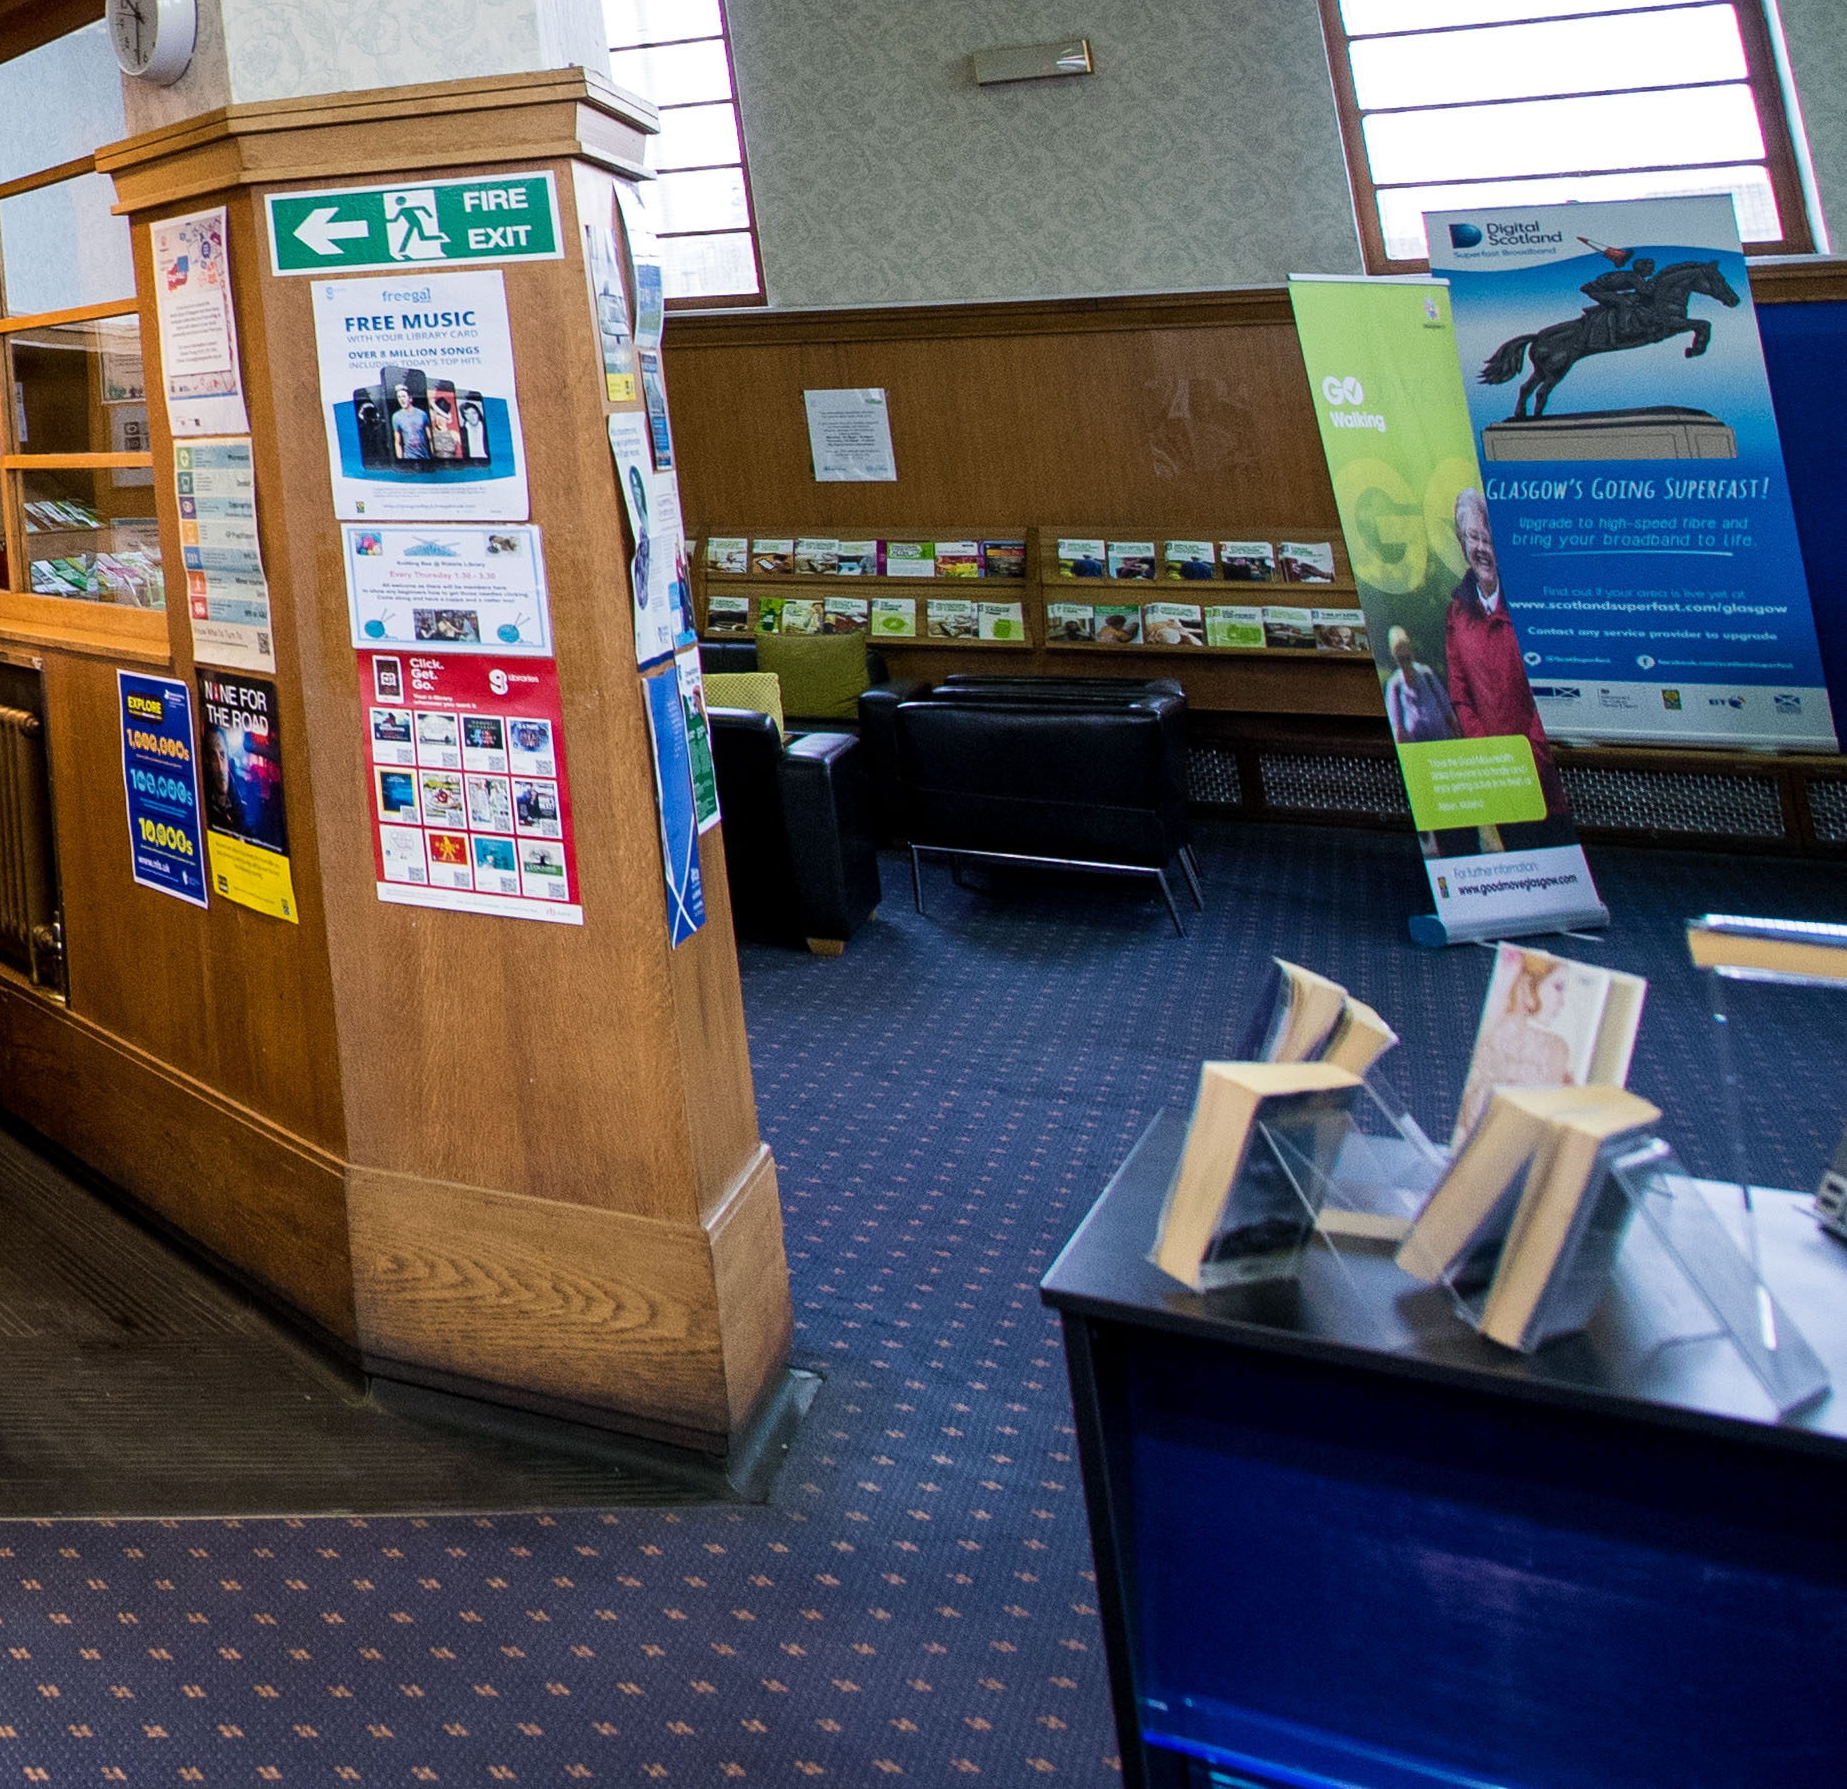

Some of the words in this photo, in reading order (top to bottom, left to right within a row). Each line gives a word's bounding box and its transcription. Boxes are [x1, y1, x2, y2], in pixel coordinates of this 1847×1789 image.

[463, 188, 528, 212] FIRE
[1486, 220, 1540, 237] Digital
[468, 225, 532, 250] EXIT
[1488, 231, 1563, 246] Scotland
[1453, 250, 1500, 259] Superfast
[1502, 247, 1557, 257] Broadband
[382, 288, 431, 303] freegal
[345, 316, 395, 332] FREE
[402, 311, 476, 329] MUSIC
[347, 334, 373, 343] WITH
[376, 333, 403, 342] YOUR
[407, 332, 447, 341] LIBRARY
[450, 330, 478, 338] CARD
[349, 351, 377, 359] OVER
[389, 348, 437, 358] MILLION
[441, 346, 480, 356] SONGS
[1329, 411, 1387, 433] Walking
[1591, 477, 1656, 500] GOING
[1664, 476, 1770, 500] SUPERFAST!
[1519, 517, 1565, 532] Upgrade
[1578, 518, 1594, 529] to
[1599, 517, 1678, 531] high-speed
[1683, 517, 1718, 529] fibre
[1722, 517, 1748, 529] and
[1512, 533, 1552, 549] bring
[1558, 534, 1596, 548] your
[1603, 533, 1690, 547] broadband
[1698, 534, 1716, 547] to
[415, 571, 451, 579] Thursday
[1543, 586, 1568, 596] Find
[1571, 587, 1592, 597] out
[1604, 588, 1633, 600] your
[1637, 588, 1668, 598] area
[1671, 587, 1680, 598] is
[1683, 588, 1705, 598] live
[1709, 590, 1727, 601] yet
[1508, 600, 1788, 615] www.scotlandsuperfast.com/glasgow
[1528, 626, 1575, 636] Contact
[1578, 628, 1600, 639] any
[1604, 628, 1646, 638] service
[1649, 629, 1702, 640] provider
[1706, 631, 1719, 639] to
[1723, 631, 1777, 641] upgrade
[409, 658, 444, 670] Click.
[411, 669, 438, 680] Get.
[412, 679, 434, 690] Go.
[127, 696, 162, 715] EXPLORE
[239, 687, 267, 711] FOR
[206, 704, 230, 728] THE
[232, 710, 269, 737] ROAD
[1454, 867, 1466, 879] For
[1458, 874, 1578, 895] www.goodmoveglasgow.com
